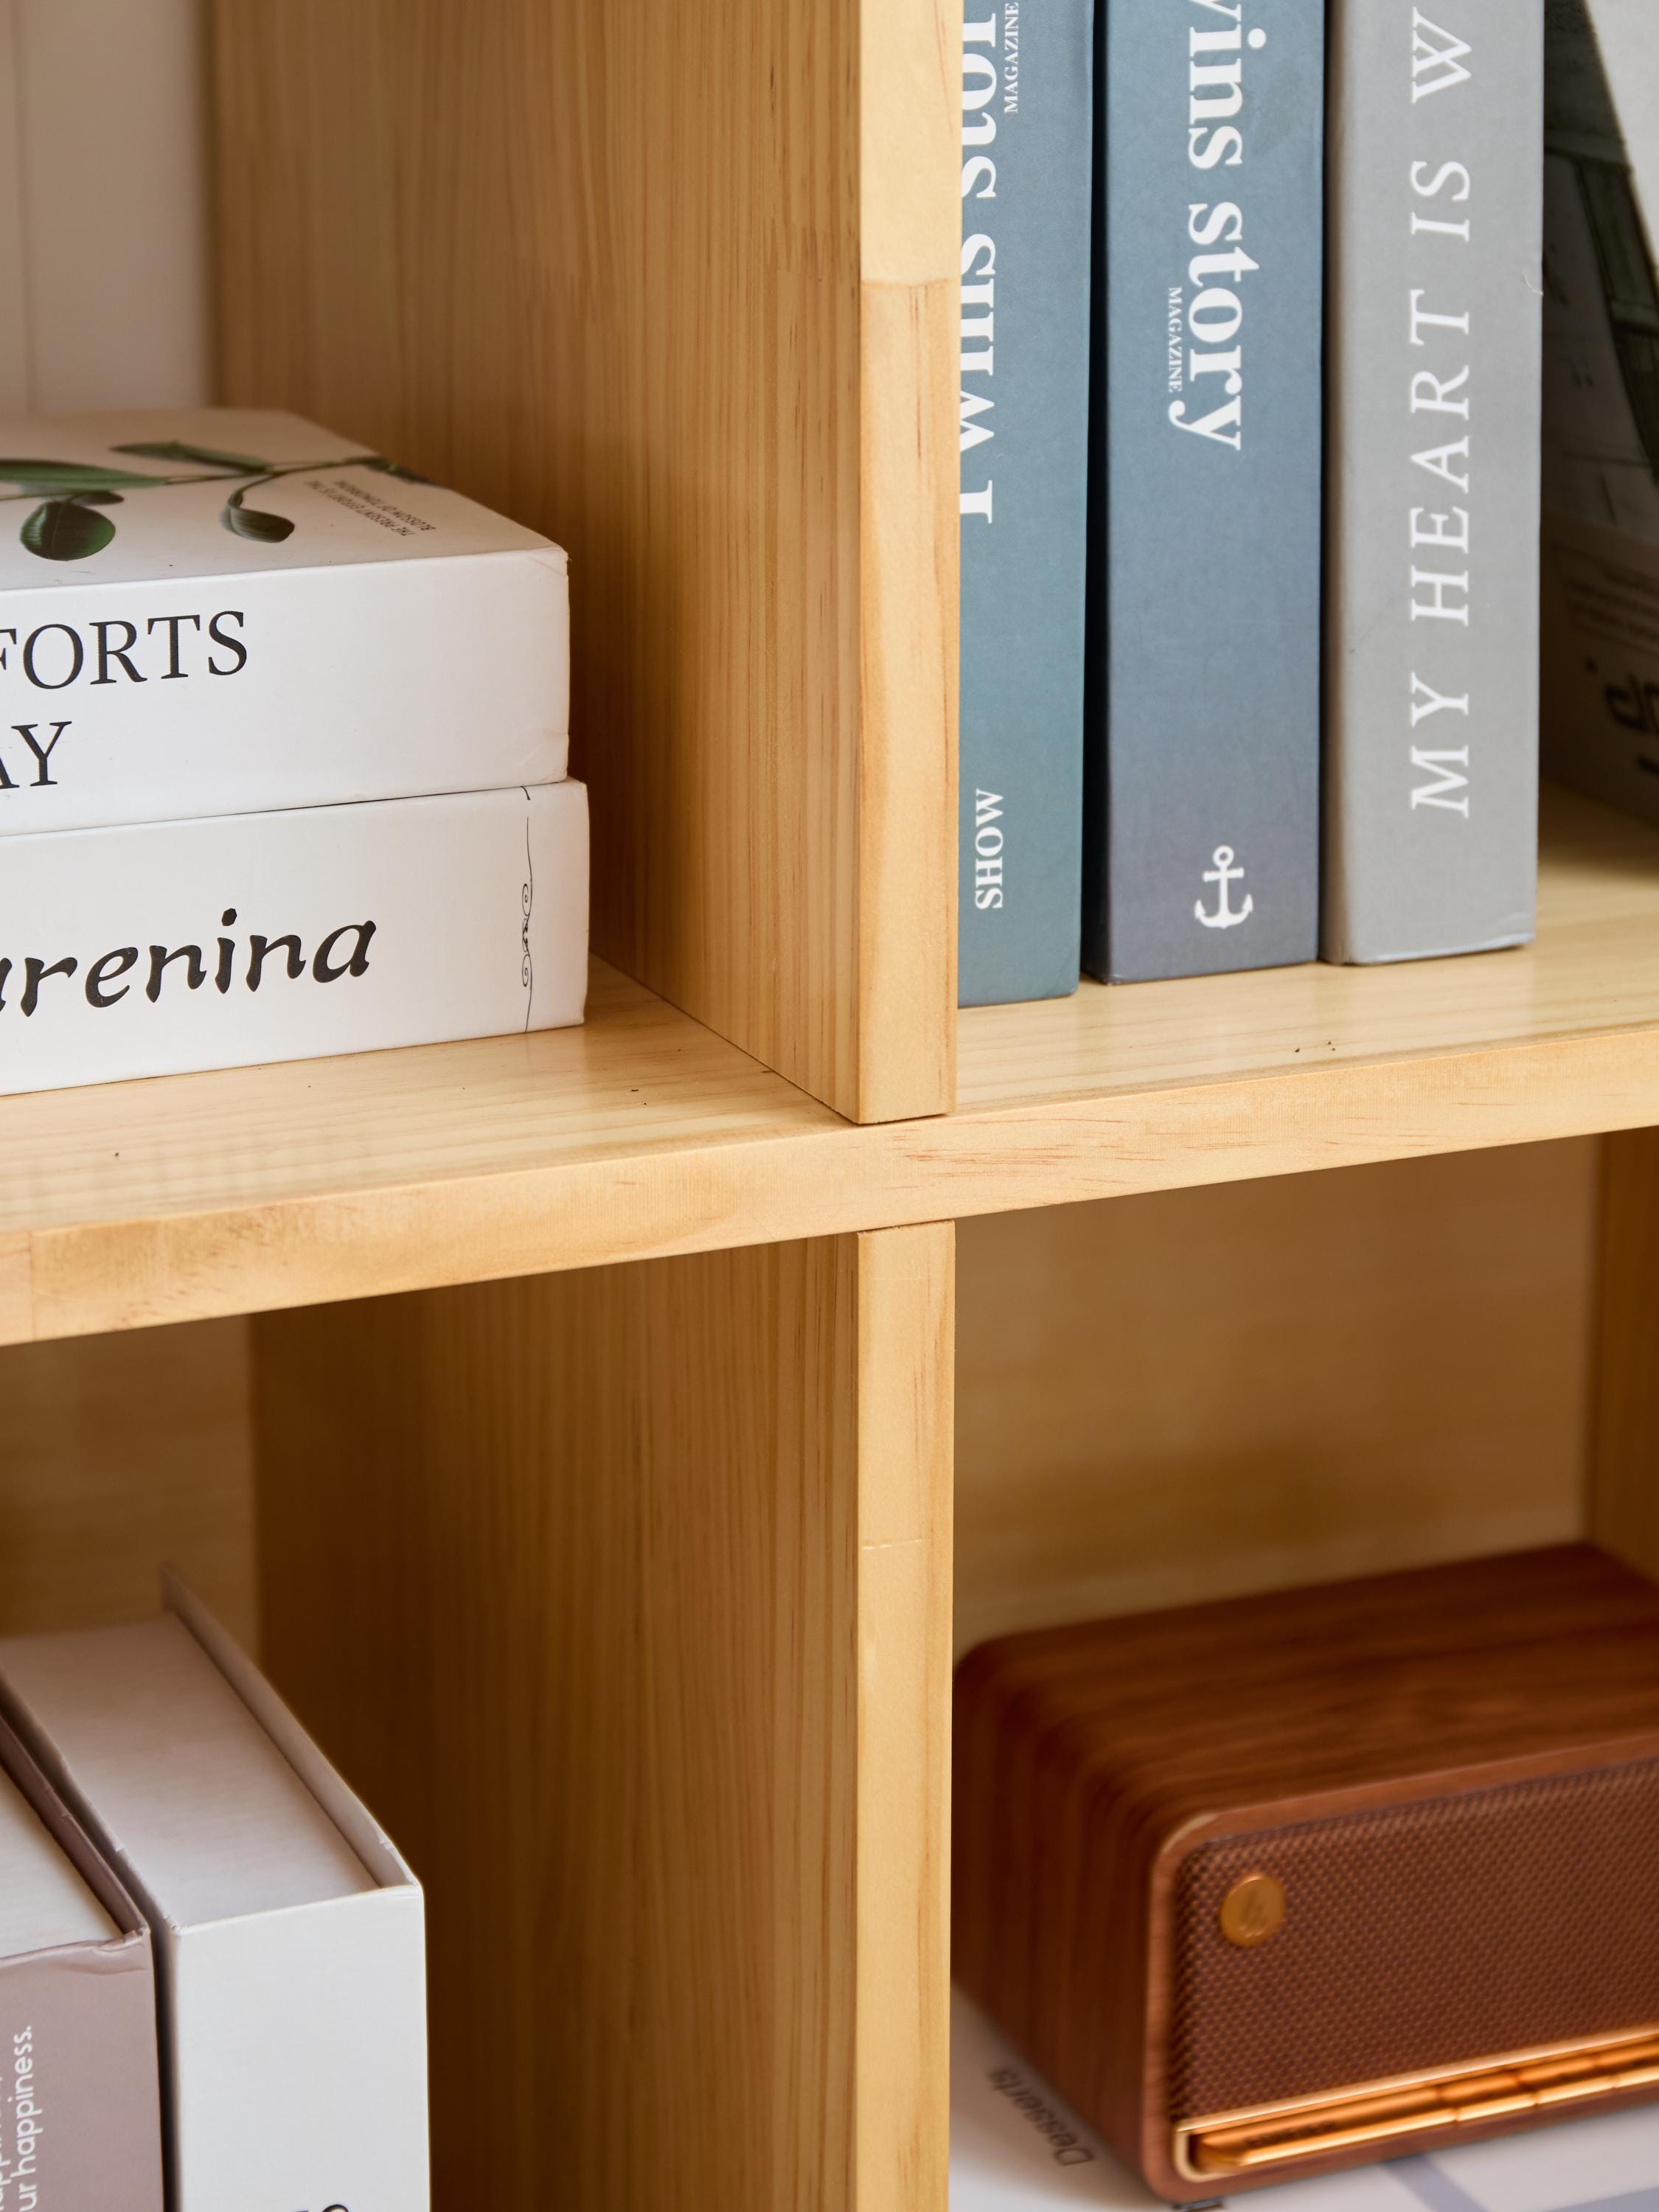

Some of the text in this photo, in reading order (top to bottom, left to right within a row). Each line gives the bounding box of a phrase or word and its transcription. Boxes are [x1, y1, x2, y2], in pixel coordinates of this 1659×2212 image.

[1003, 1, 1020, 114] MAGAZINE
[1167, 286, 1183, 393] MAGAZINE
[1168, 201, 1260, 451] story
[1408, 7, 1472, 818] MY HEART IS W
[974, 788, 1004, 910] SHOW
[0, 907, 378, 1018] renina
[7, 2025, 44, 2212] ur happiness.
[987, 2067, 1096, 2168] Desserts
